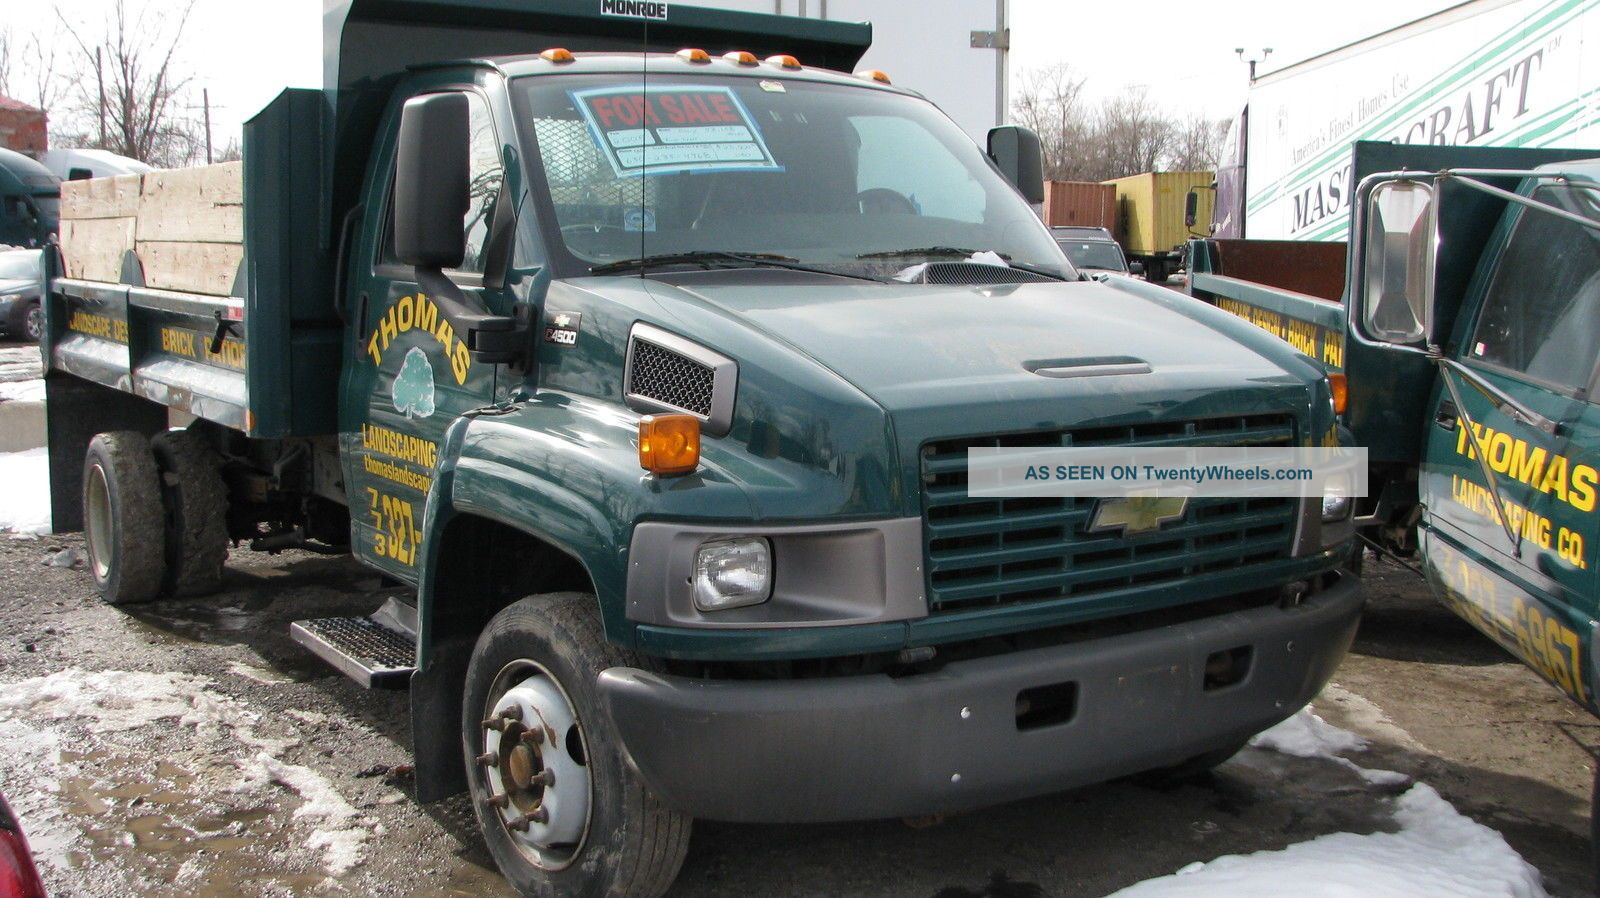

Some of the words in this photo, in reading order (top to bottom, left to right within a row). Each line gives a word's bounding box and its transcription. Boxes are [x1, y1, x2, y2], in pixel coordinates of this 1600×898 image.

[602, 0, 665, 18] MONROE
[592, 95, 661, 127] FOR
[660, 94, 738, 123] SALE
[1328, 111, 1354, 142] Finest
[1358, 91, 1388, 123] Homes
[1392, 73, 1409, 98] Use
[162, 328, 196, 358] BRICK
[367, 292, 471, 386] THOMAS
[363, 423, 437, 469] LANDSCAPING
[1456, 416, 1599, 512] THOMAS
[1557, 527, 1587, 569] CO.
